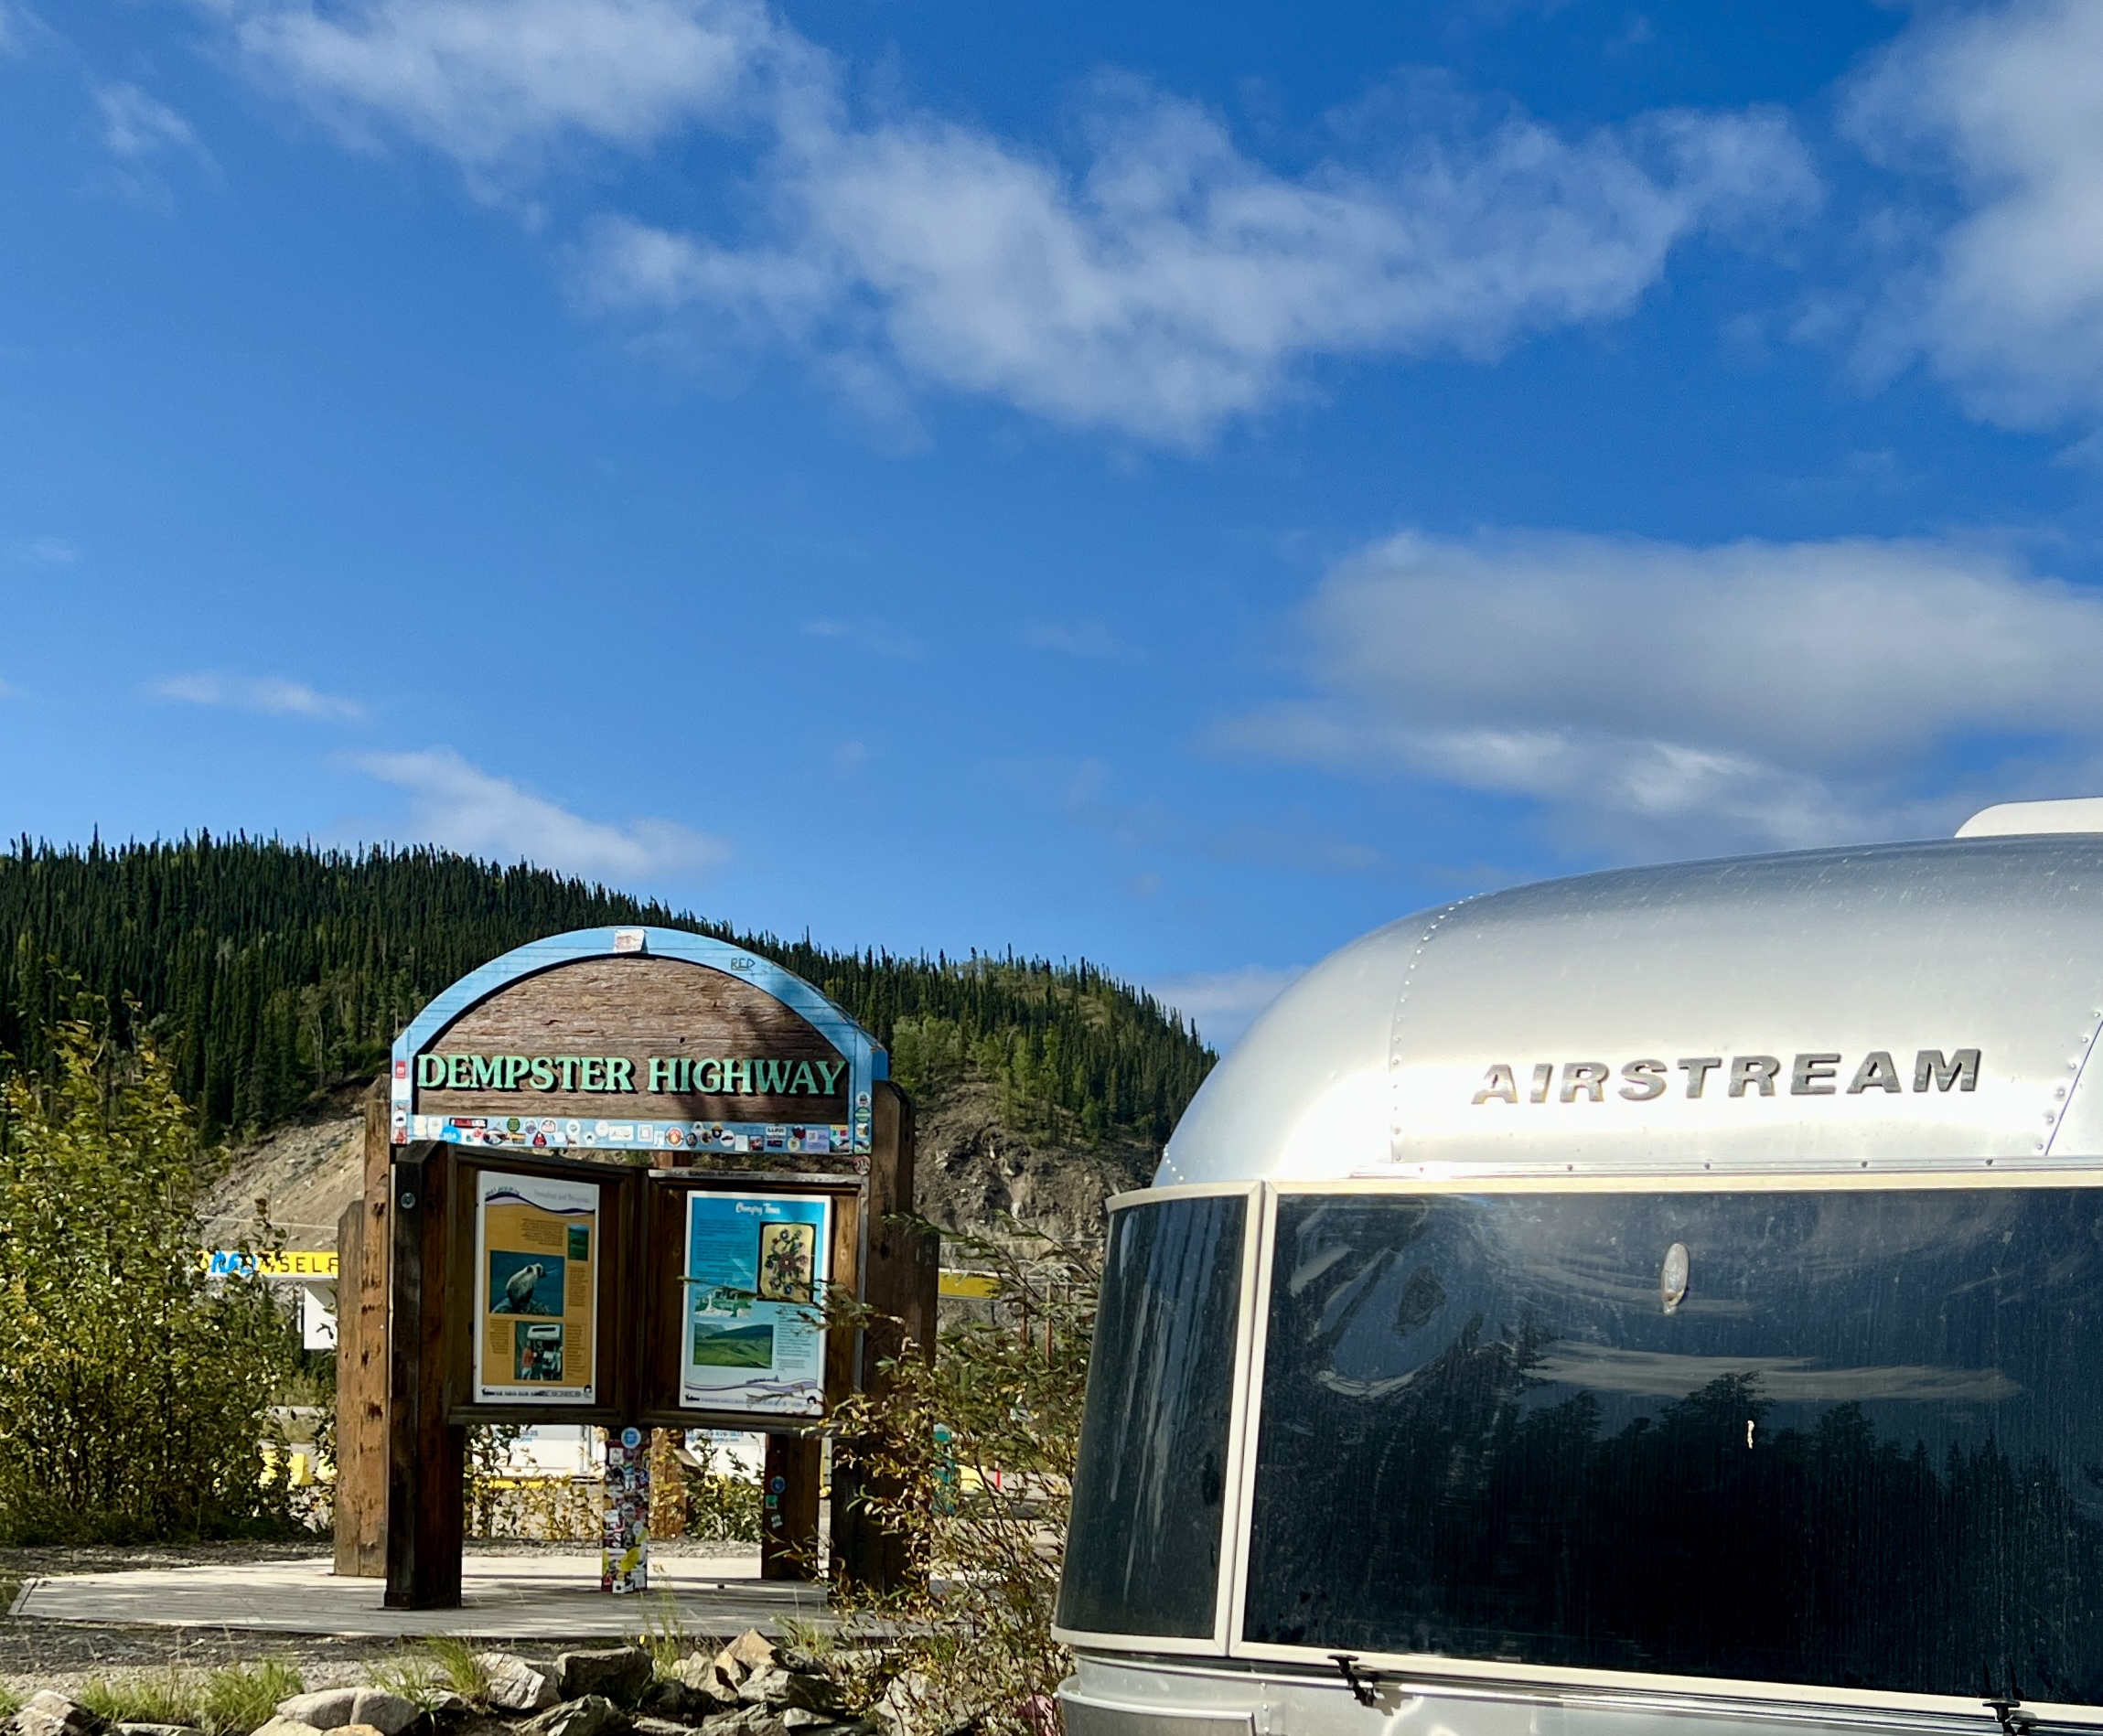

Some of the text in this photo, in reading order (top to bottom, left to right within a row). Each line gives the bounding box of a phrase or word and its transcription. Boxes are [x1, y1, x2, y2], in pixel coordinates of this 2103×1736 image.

[417, 1055, 846, 1095] DEMPSTER HIGHWAY
[1471, 1049, 1981, 1105] AIRSTREAM
